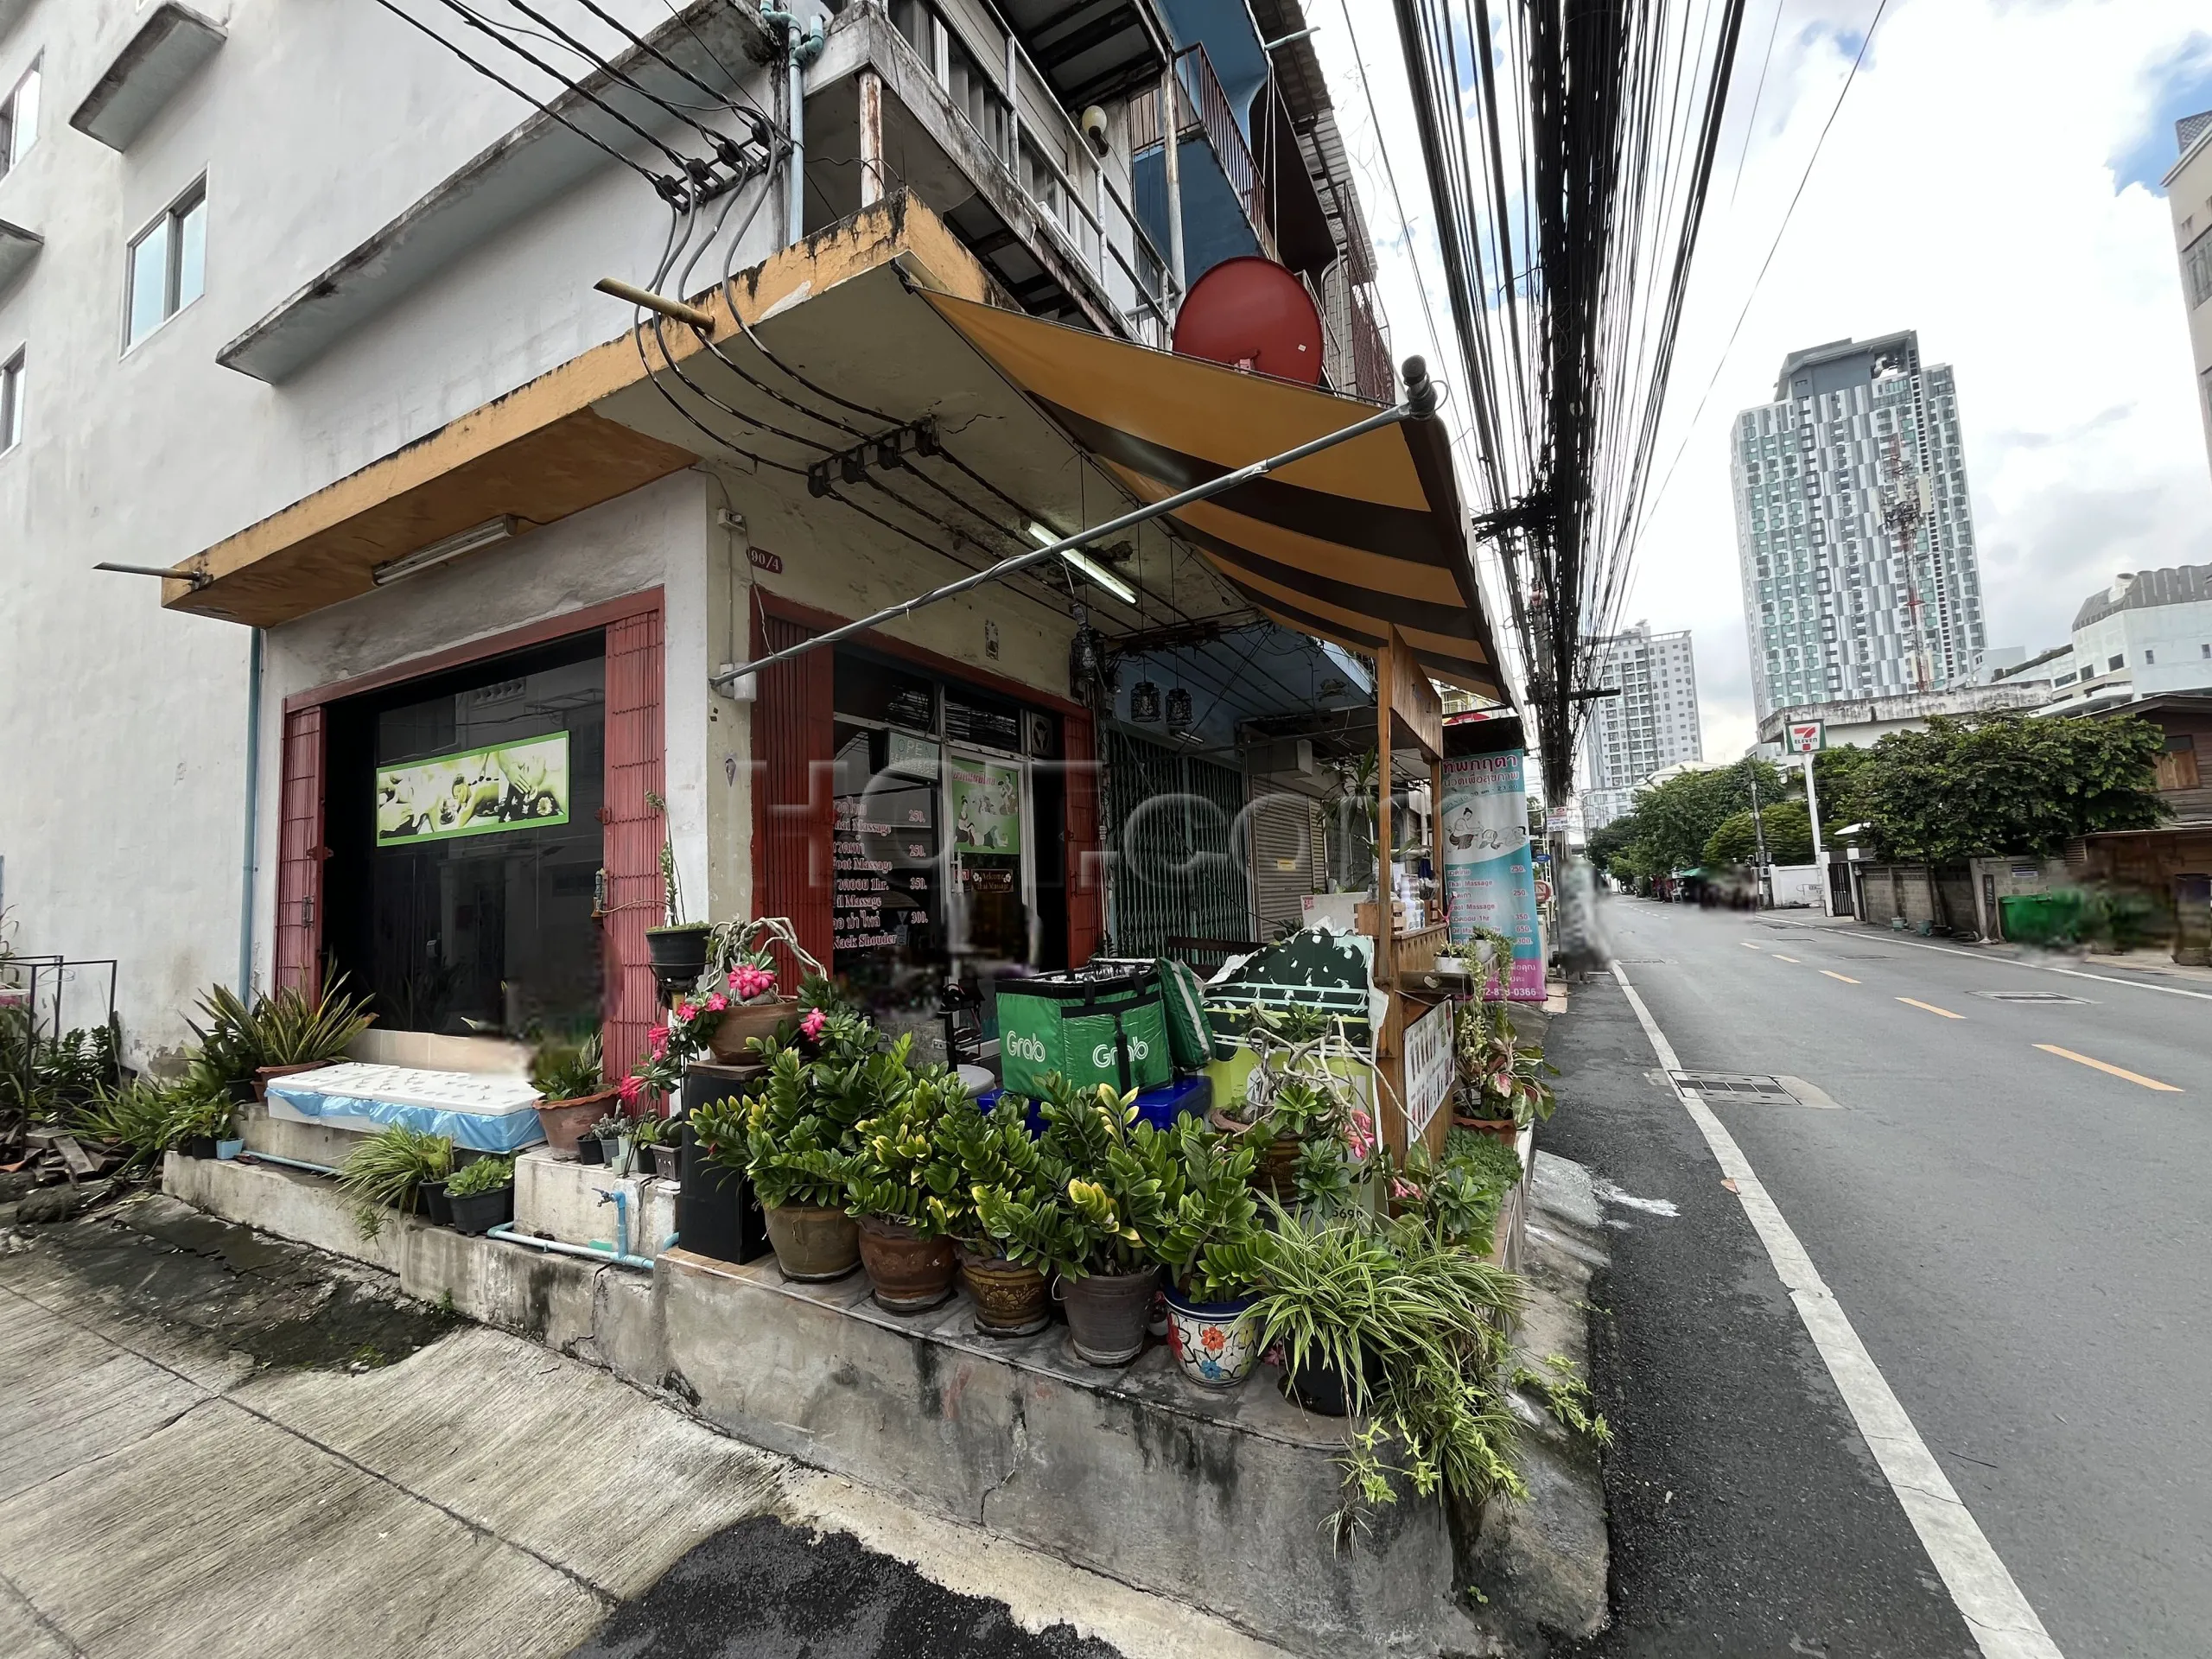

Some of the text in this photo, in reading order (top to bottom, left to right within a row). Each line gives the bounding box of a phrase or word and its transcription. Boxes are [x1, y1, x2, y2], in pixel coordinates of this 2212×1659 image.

[751, 550, 779, 570] 90/4
[1794, 727, 1816, 738] 7
[897, 739, 931, 759] OPEN
[1444, 772, 1520, 787] นวดเพื่อสุขภาพ
[852, 818, 892, 836] Massage
[853, 858, 893, 874] Massage
[845, 895, 882, 911] Massage
[1007, 1030, 1046, 1063] Grab
